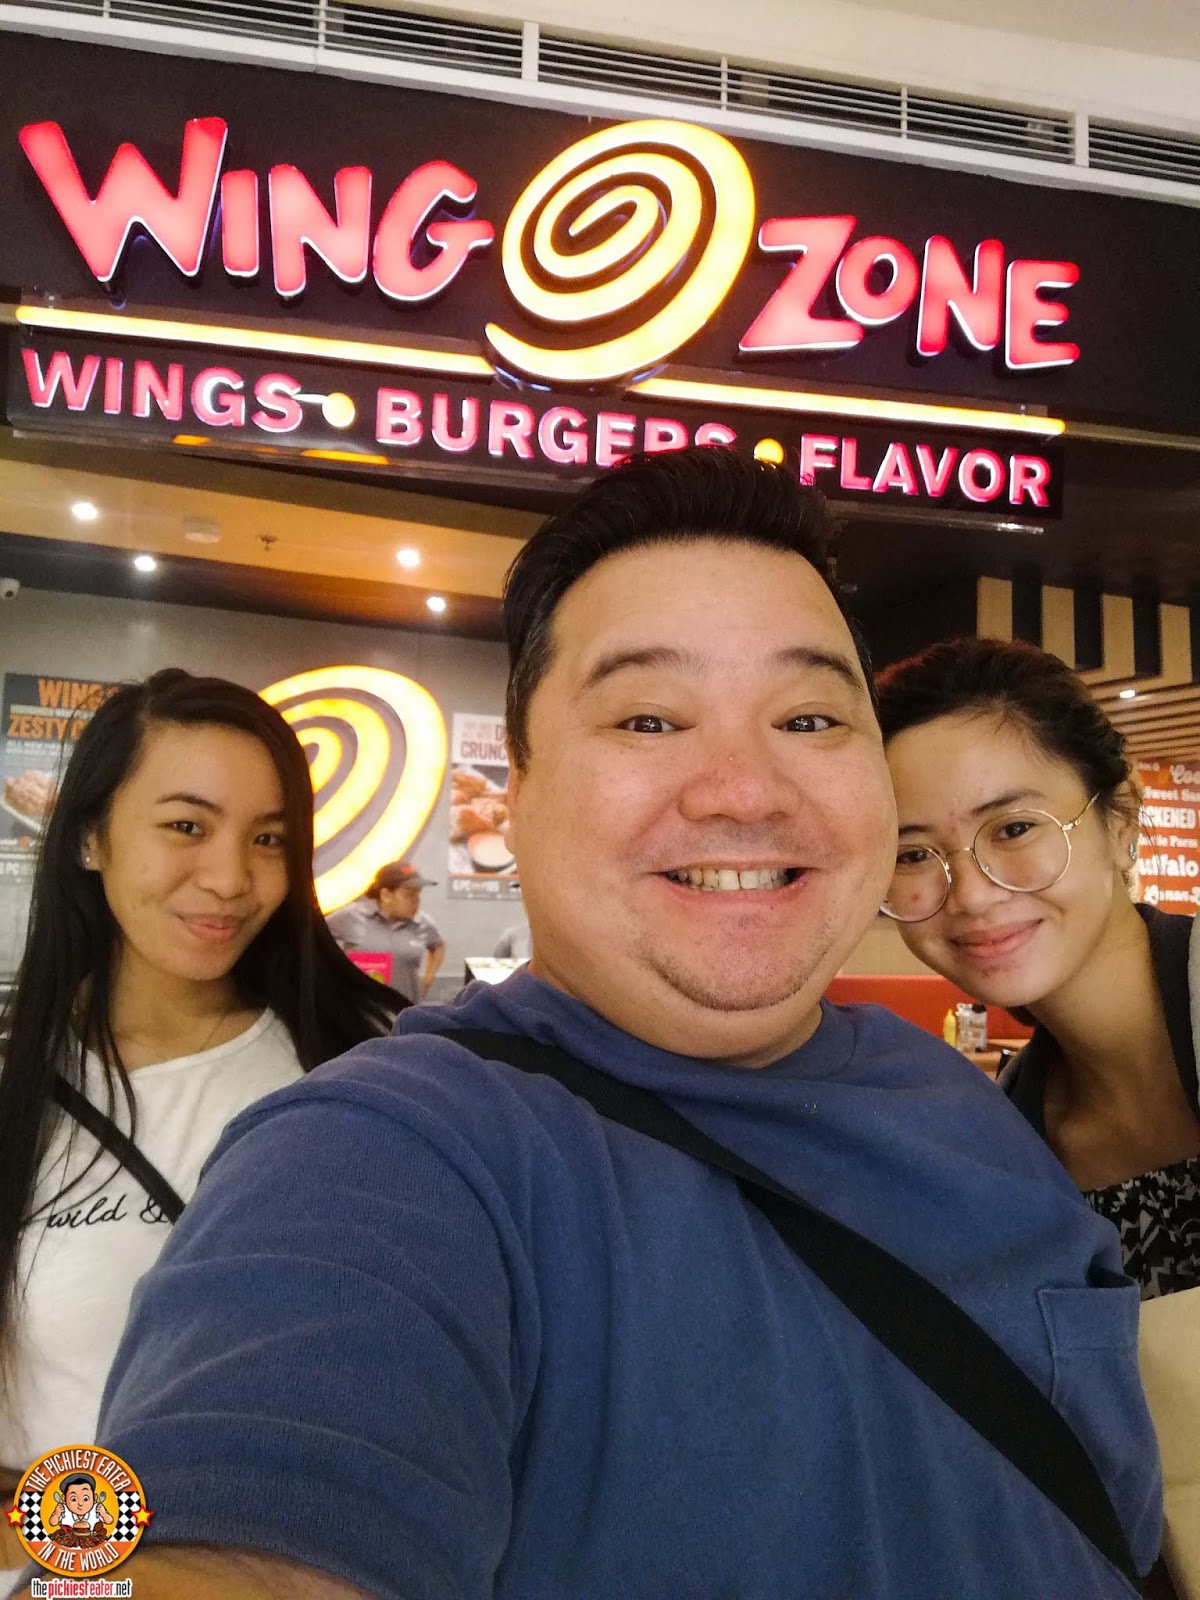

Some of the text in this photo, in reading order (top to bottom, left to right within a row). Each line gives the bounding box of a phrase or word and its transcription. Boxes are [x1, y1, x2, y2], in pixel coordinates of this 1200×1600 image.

[19, 116, 1081, 370] WING ZONE
[21, 347, 304, 433] WINGS
[800, 433, 1051, 508] FLAVOR
[38, 678, 119, 713] WING
[7, 715, 69, 740] ZESTY
[461, 740, 508, 761] CRUNC
[47, 1194, 127, 1229] wild
